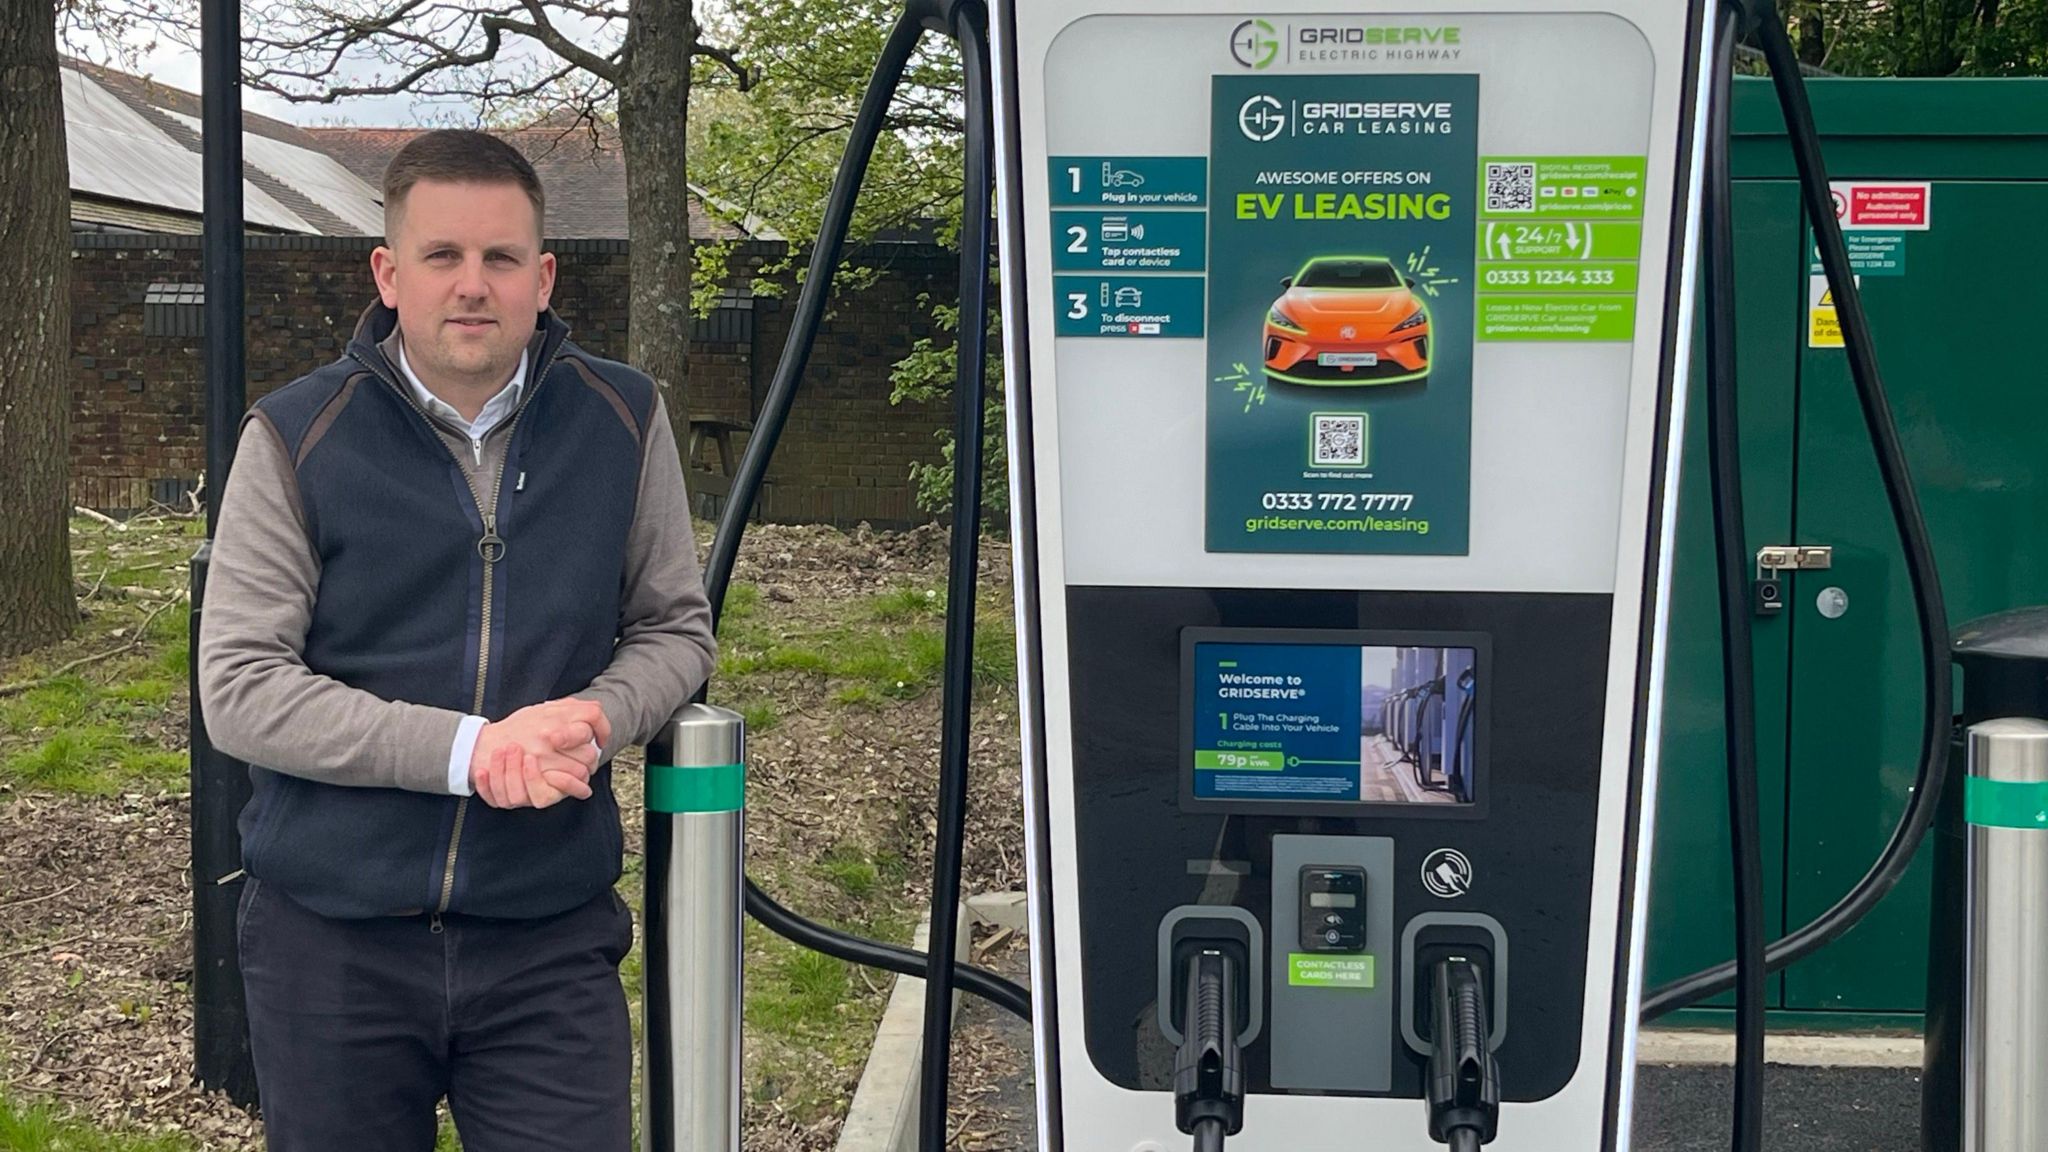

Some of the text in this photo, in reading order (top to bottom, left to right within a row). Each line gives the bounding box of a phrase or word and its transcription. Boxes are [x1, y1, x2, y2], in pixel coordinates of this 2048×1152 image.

[1300, 27, 1461, 45] GRIDSERVE
[1299, 49, 1461, 60] ELECTRIC HIGHWAY
[1303, 103, 1452, 118] GRIDSERVE
[1303, 121, 1452, 134] CAR LEASING
[1067, 167, 1081, 193] 1
[1255, 171, 1432, 185] AWESOME OFFERS ON
[1101, 192, 1198, 204] Plug in your vehicle
[1856, 191, 1920, 200] No admittance
[1236, 193, 1451, 220] EV LEASING
[1857, 212, 1918, 221] personnel only
[1066, 226, 1088, 253] 2
[1515, 227, 1563, 244] 24/7
[1861, 236, 1902, 244] Emergencies
[1101, 247, 1181, 258] Tap contactless
[1515, 246, 1561, 254] SUPPORT
[1101, 257, 1171, 267] card or device
[1486, 269, 1615, 285] 0333 1234 333
[1067, 293, 1088, 320] 3
[1486, 304, 1513, 312] Lease
[1522, 304, 1543, 312] New
[1545, 304, 1579, 312] Electric
[1580, 304, 1596, 312] Car
[1101, 313, 1171, 323] To disconnect
[1485, 314, 1540, 322] GRIDSERVE
[1541, 314, 1557, 322] Car
[1815, 318, 1840, 329] Dang
[1100, 325, 1127, 334] press
[1262, 493, 1414, 511] 0333 772 7777
[1245, 515, 1429, 535] gridserve.com/leasing
[1218, 673, 1302, 686] Welcome to
[1218, 713, 1228, 730] 1
[1233, 712, 1320, 724] Plug The Charging
[1233, 722, 1340, 733] Cable Into Your Vehicle
[1217, 739, 1257, 749] Charging
[1217, 754, 1248, 768] 79p
[1296, 960, 1365, 970] CONTACTLESS
[1300, 970, 1362, 981] CARDS HERE
